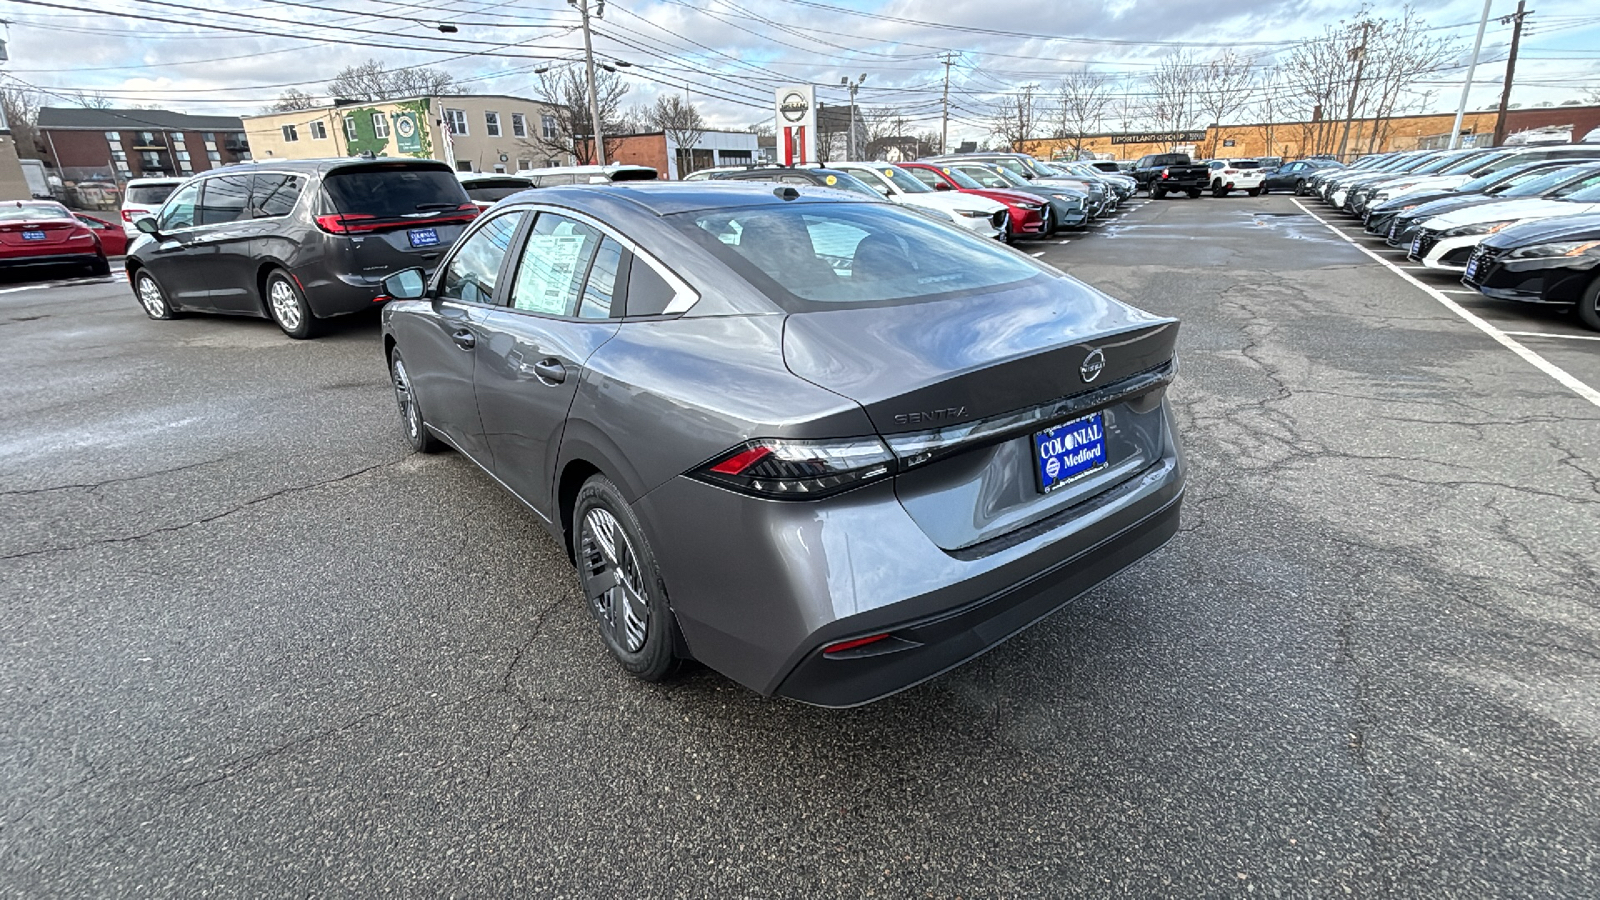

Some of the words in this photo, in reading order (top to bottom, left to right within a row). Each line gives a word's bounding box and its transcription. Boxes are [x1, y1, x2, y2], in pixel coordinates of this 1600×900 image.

[1080, 361, 1106, 373] NISSAN
[894, 406, 969, 425] SENTRA
[1041, 424, 1102, 459] COLONIAL
[1063, 443, 1101, 469] Medford
